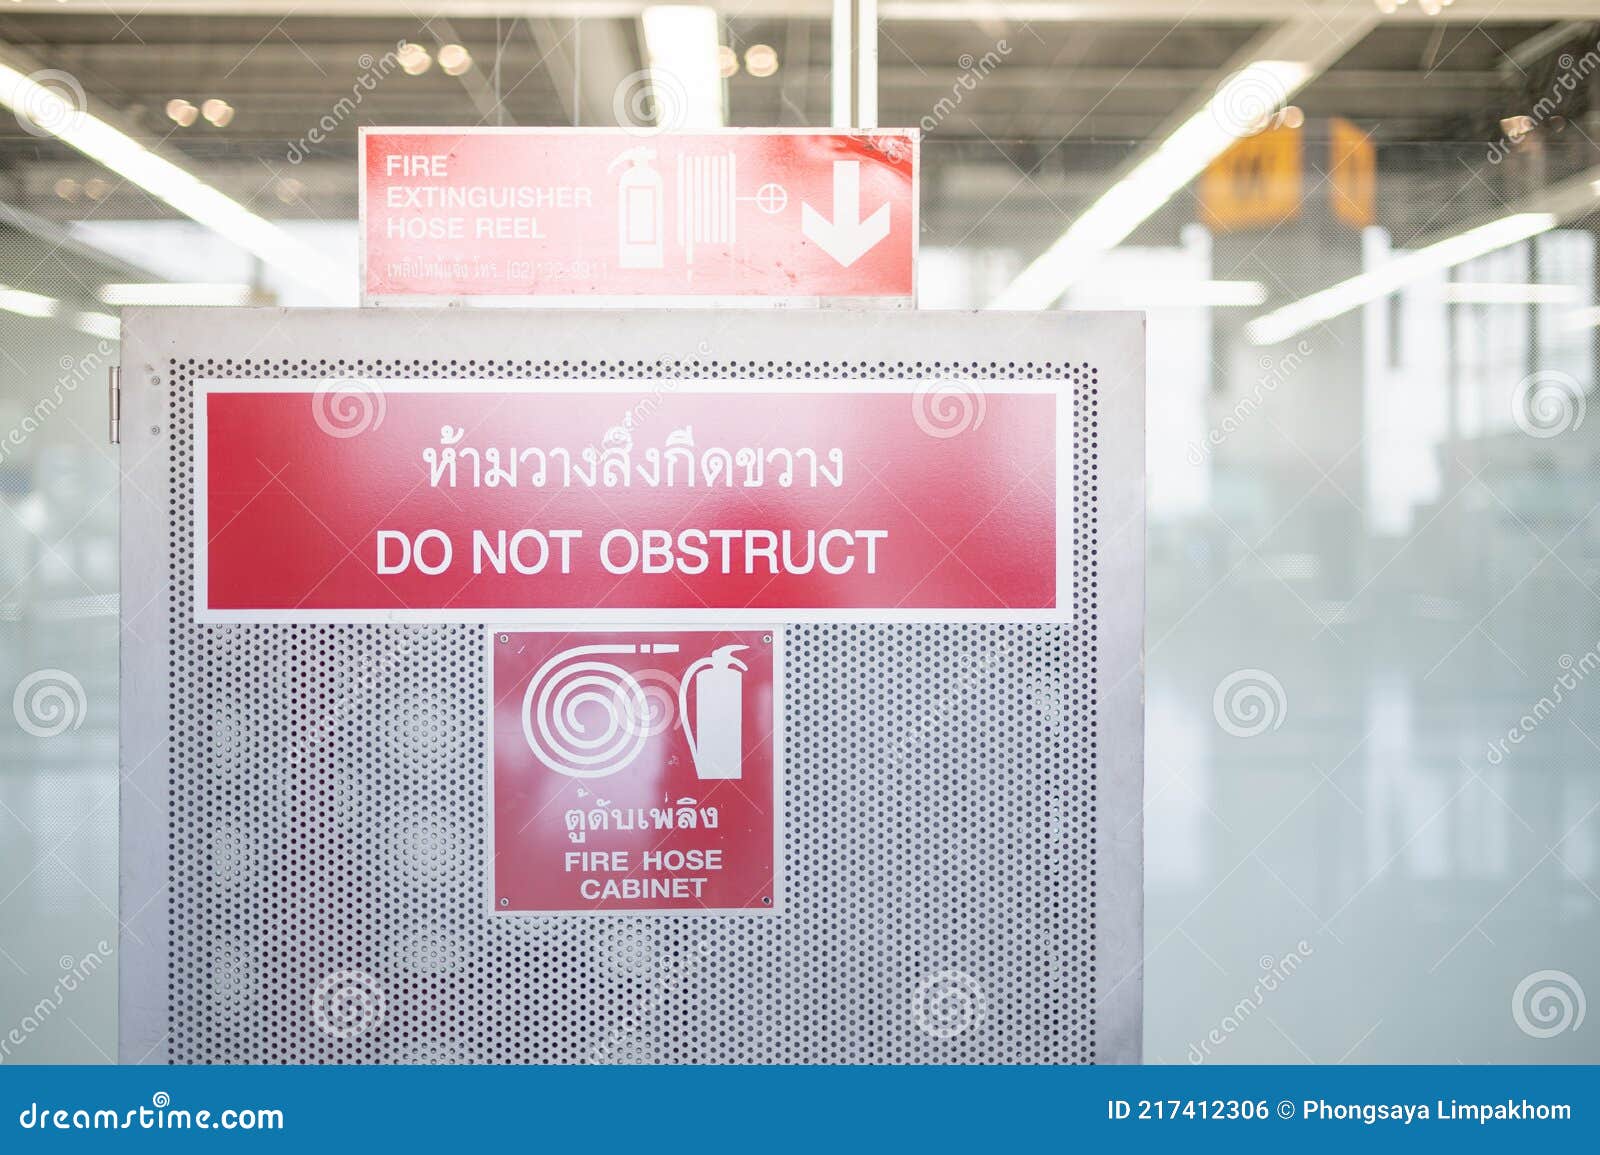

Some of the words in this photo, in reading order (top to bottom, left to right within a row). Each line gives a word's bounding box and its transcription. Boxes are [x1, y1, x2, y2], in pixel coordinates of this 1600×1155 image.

[386, 155, 448, 177] FIRE
[386, 186, 593, 209] EXTINGUISHER
[386, 216, 464, 240] HOSE
[475, 217, 546, 239] REEL
[422, 411, 844, 488] ห้ามวางสิ่งกีดขวาง
[376, 529, 453, 575] DO
[472, 529, 583, 575] NOT
[600, 529, 889, 575] OBSTRUCT
[564, 851, 629, 872] FIRE
[643, 850, 723, 871] HOSE
[580, 878, 708, 899] CABINET
